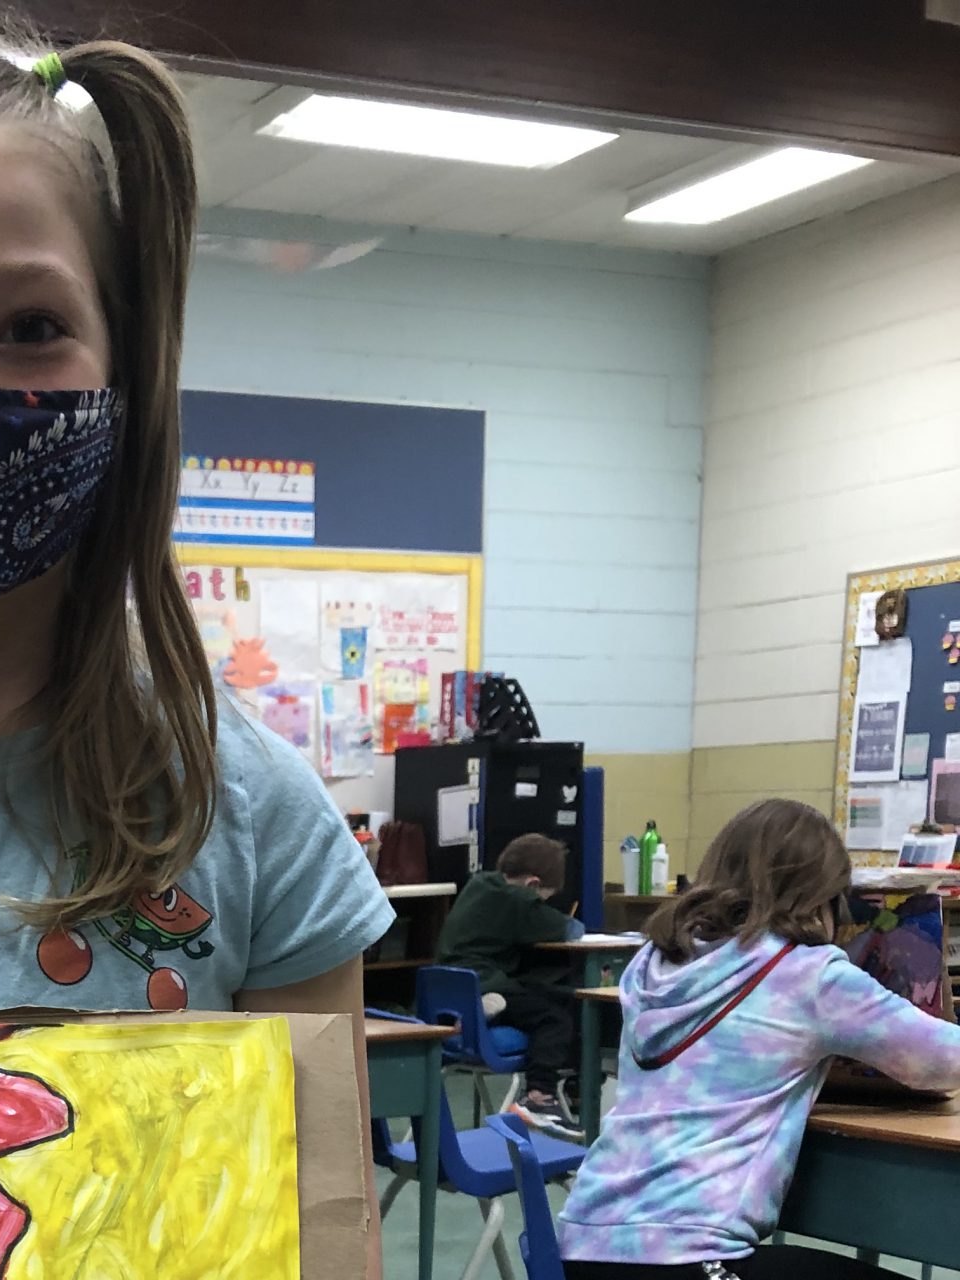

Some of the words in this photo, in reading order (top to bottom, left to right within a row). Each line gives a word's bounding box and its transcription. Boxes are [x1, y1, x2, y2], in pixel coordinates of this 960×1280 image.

[200, 472, 222, 489] Xx
[241, 473, 260, 498] Yy
[279, 475, 299, 493] Zz
[186, 566, 251, 602] ath
